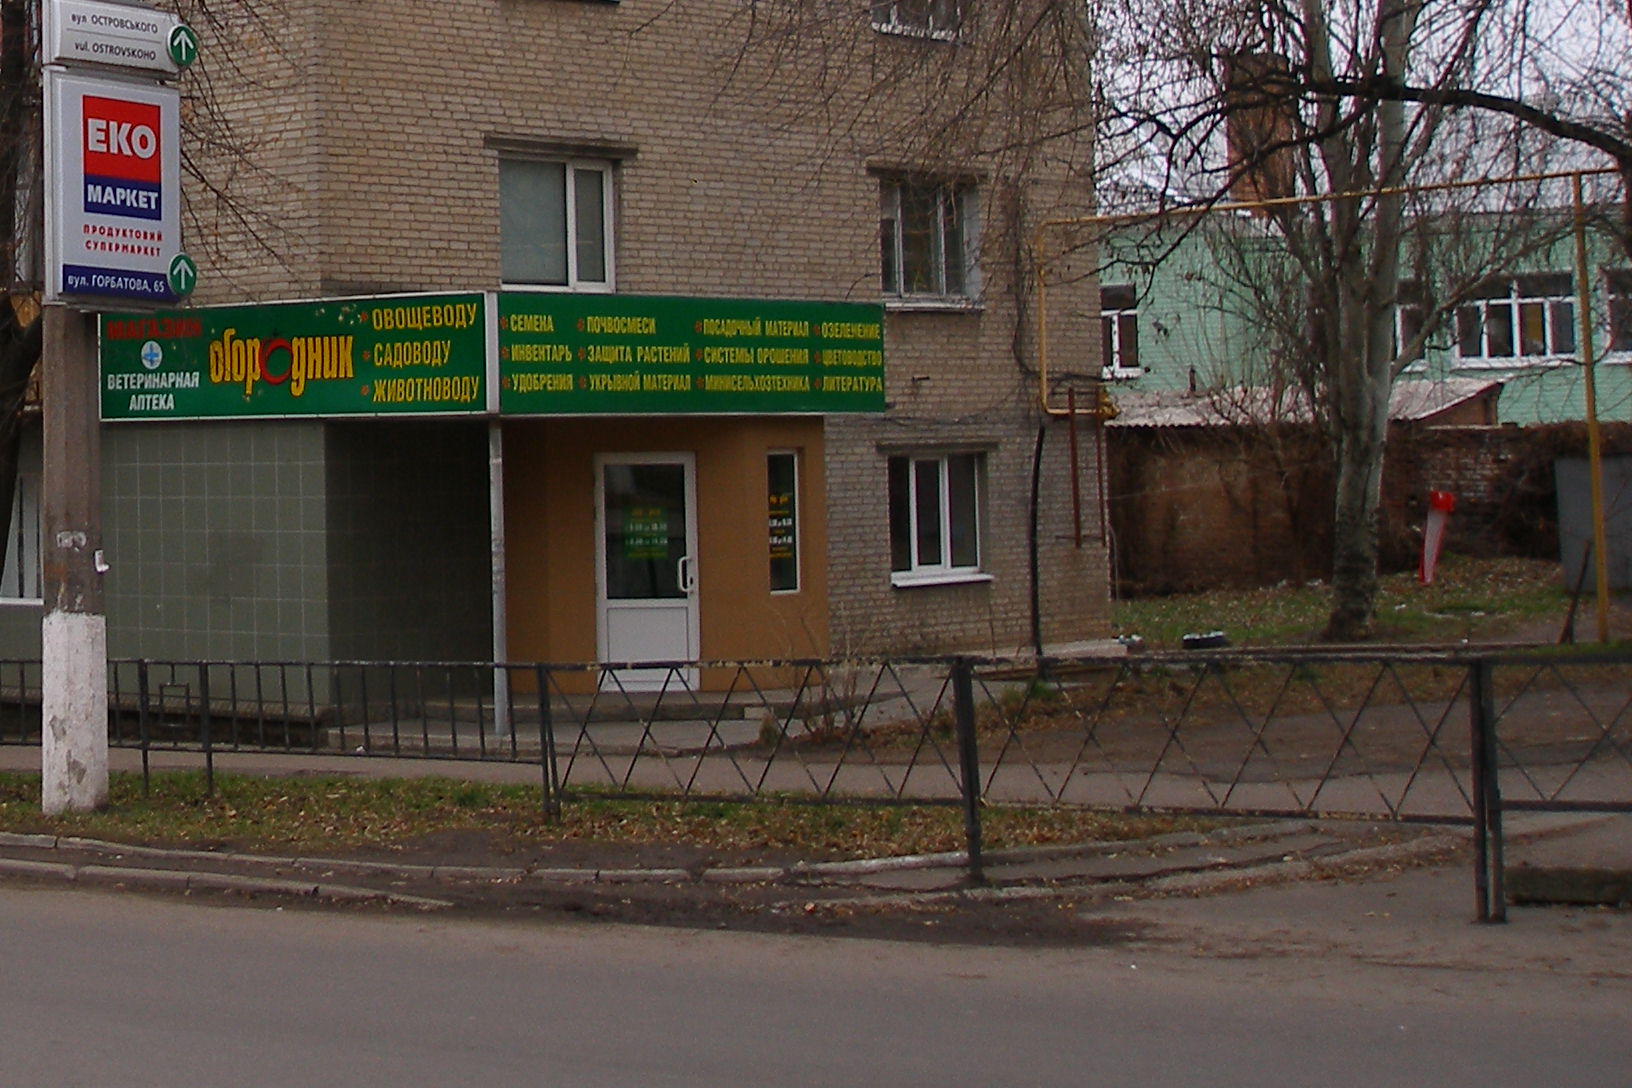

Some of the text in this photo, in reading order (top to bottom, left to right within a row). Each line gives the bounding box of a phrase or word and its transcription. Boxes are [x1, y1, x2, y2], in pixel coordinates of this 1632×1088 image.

[91, 14, 158, 34] ОСТРОВСЬКОГО
[74, 41, 157, 61] vul. OSTROVSKOHO
[87, 117, 157, 159] ЕКО
[87, 183, 158, 210] МАРКЕТ
[83, 223, 163, 241] ПРОДУКТОВИЙ
[85, 240, 160, 257] СУПЕРМАРКЕТ
[67, 274, 165, 292] вул. ГОРБАТОВА, 65
[372, 303, 477, 331] ОВОЩЕВОДУ
[510, 314, 554, 332] СЕМЕНА
[586, 316, 656, 334] ПОЧВОСМЕСИ
[106, 317, 204, 340] МАГАЗИН
[703, 316, 809, 338] ПОСАДОЧНЫЙ МАТЕРИАЛ
[822, 322, 881, 340] ОЗЕЛЕНЕНИЕ
[374, 340, 451, 368] САДОВОДУ
[510, 344, 573, 362] ИНВЕНТАРЬ
[587, 342, 691, 364] ЗАЩИТА РАСТЕНИЙ
[704, 346, 809, 364] СИСТЕМЫ ОРОШЕНИЯ
[822, 349, 882, 367] ЦВЕТОВОДСТВО
[107, 371, 200, 390] ВЕТЕРИНАРНАЯ
[372, 375, 479, 403] ЖИВОТНОВОДУ
[511, 373, 574, 393] УДОБРЕНИЯ
[588, 370, 691, 392] УКРЫВНОЙ МАТЕРИАЛ
[704, 374, 810, 392] МИНИСЕЛЬХОЗТЕХНИКА
[822, 375, 883, 393] ЛИТЕРАТУРА
[129, 393, 175, 411] АПТЕКА
